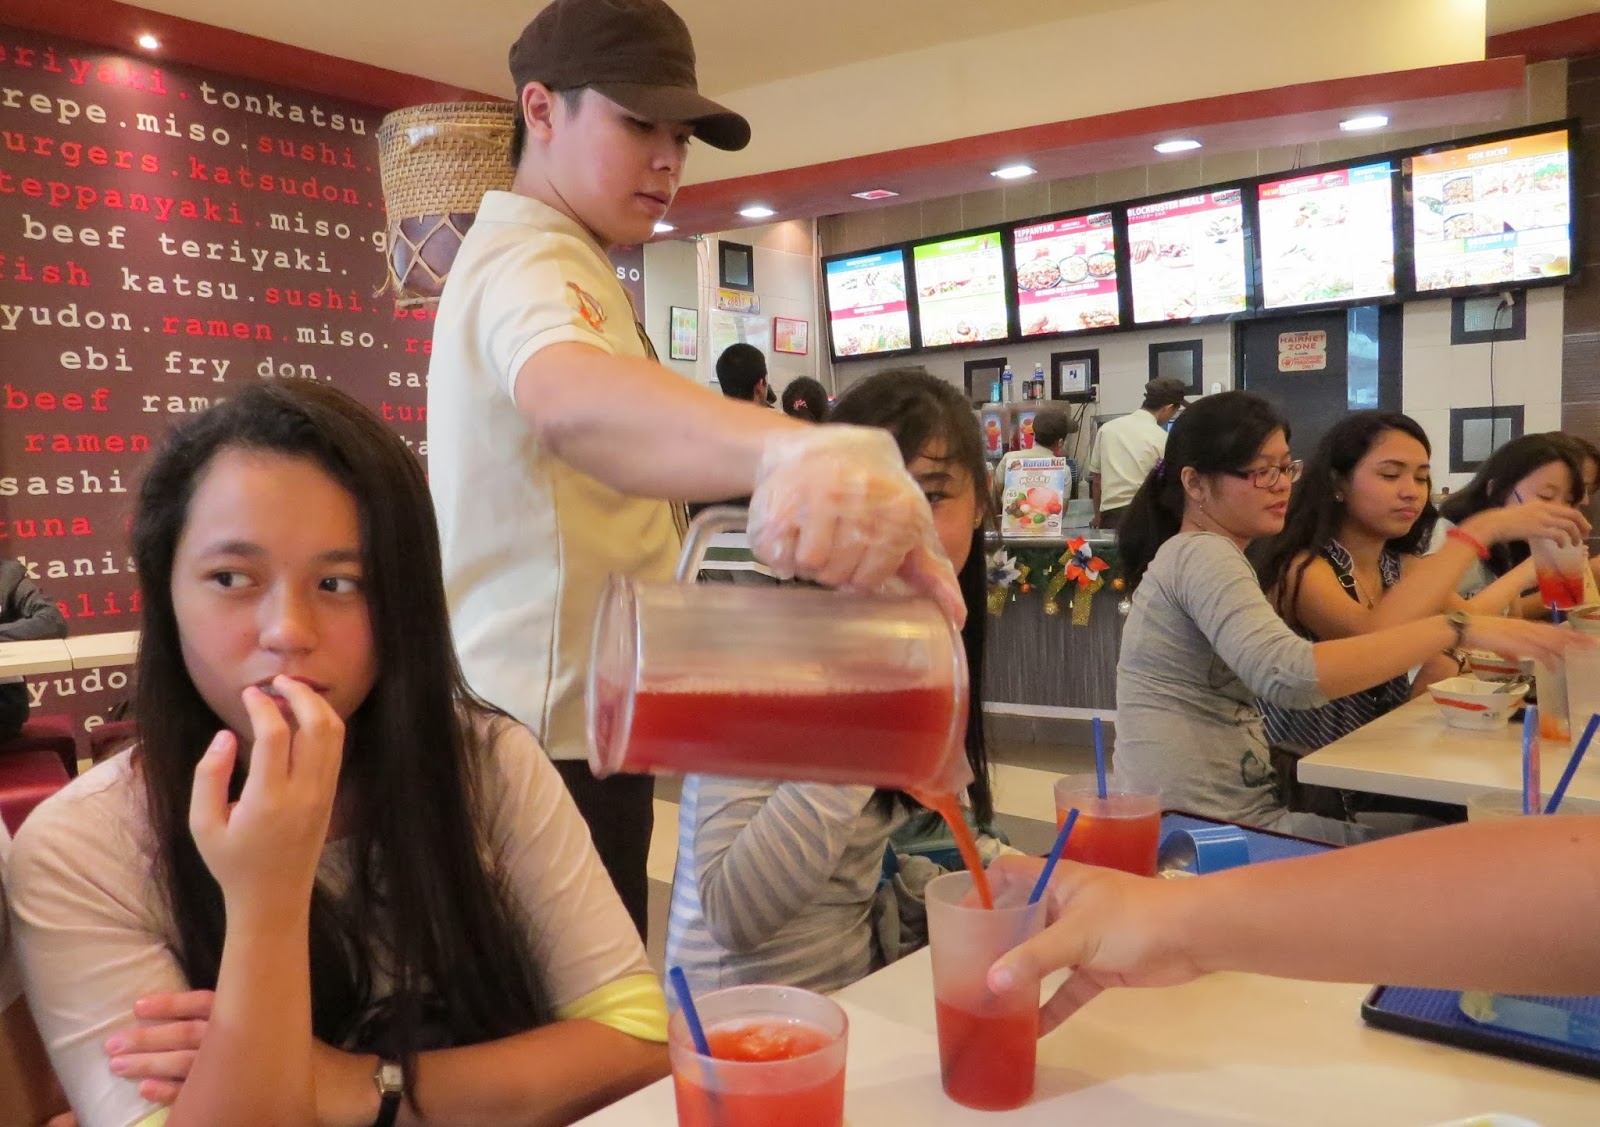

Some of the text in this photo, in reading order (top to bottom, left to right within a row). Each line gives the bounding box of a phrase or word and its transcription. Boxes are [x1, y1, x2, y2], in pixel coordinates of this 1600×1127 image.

[1127, 199, 1179, 217] BLOCKBUSTER
[1179, 194, 1205, 208] MEALS
[1014, 223, 1055, 238] TEPPANYAKI
[22, 213, 348, 275] beef teriyaki.
[1280, 334, 1325, 344] HAIRNET
[1288, 343, 1317, 351] ZONE
[60, 346, 133, 372] ebi
[165, 351, 231, 382] fry
[4, 383, 112, 412] beef
[25, 433, 150, 452] ramen
[0, 469, 127, 496] sashi
